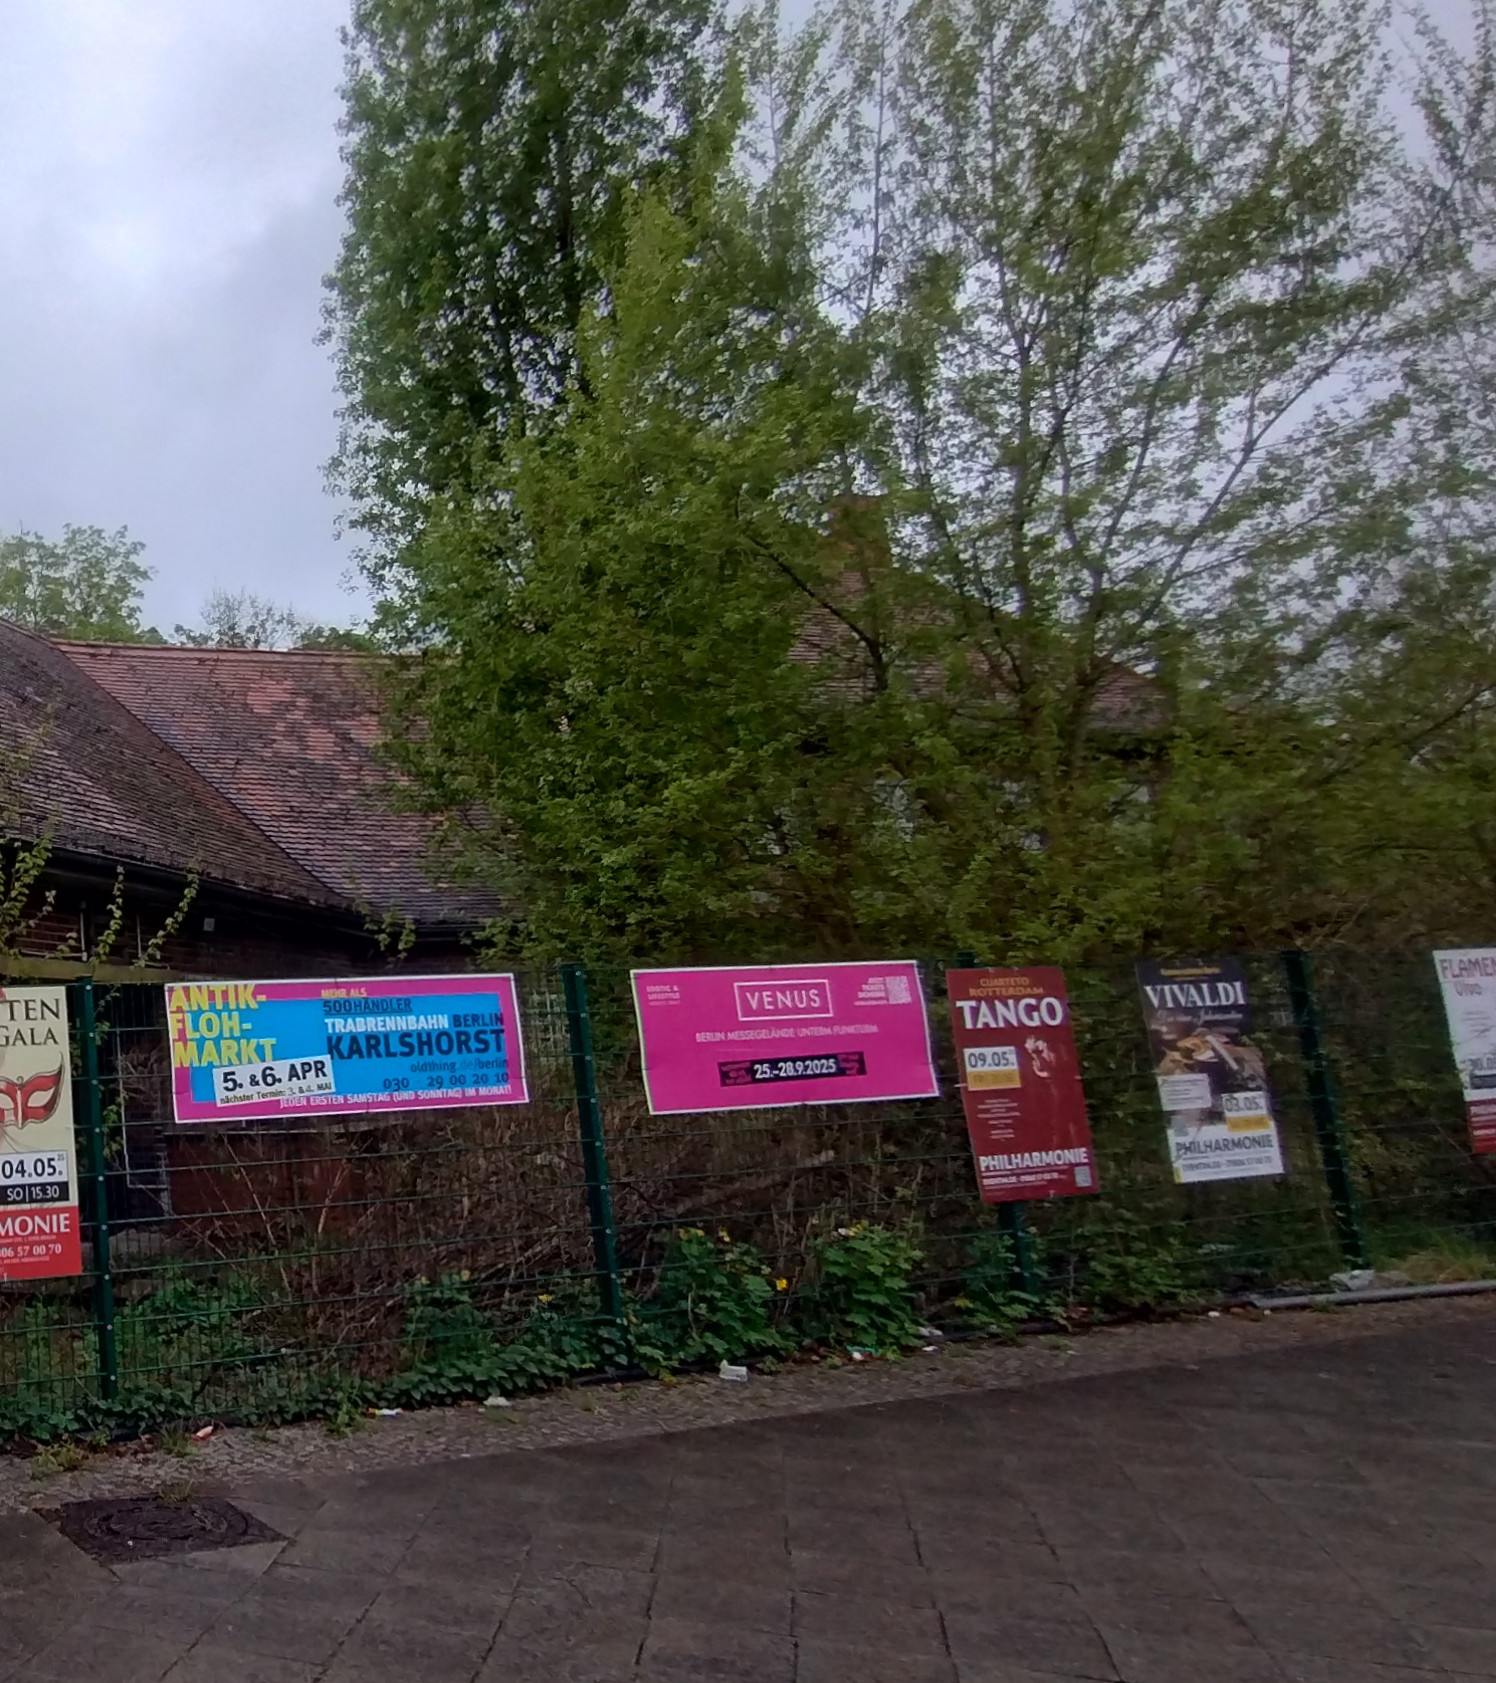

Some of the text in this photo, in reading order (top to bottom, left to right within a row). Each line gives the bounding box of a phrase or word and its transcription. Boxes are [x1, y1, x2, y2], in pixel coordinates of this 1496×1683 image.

[169, 984, 267, 1011] ANTIK-
[350, 987, 367, 998] ALS
[746, 989, 821, 1010] VENUS
[968, 987, 1044, 997] ROTTERDAM
[1144, 981, 1246, 1009] VIVALDI
[324, 1012, 504, 1033] TRABRENNBAHN BERLIN
[955, 997, 1063, 1029] TANGO
[169, 1011, 252, 1039] FLOH-
[695, 1031, 725, 1042] BERLIN
[727, 1027, 795, 1041] MESSEGELÄNDE
[797, 1026, 832, 1037] UNTERM
[173, 1038, 277, 1068] MARKT
[326, 1028, 505, 1061] KARLSHORST
[968, 1051, 1015, 1068] 09.05.
[222, 1070, 244, 1092] 5.
[287, 1060, 328, 1082] APR
[383, 1072, 509, 1091] 030 29 00 20 10
[220, 1093, 254, 1105] nächster
[280, 1084, 512, 1109] JEDEN ERSTEN SAMSTAG (UND SONNTAG) IM MONAT!
[1175, 1134, 1273, 1156] PHILHARMONIE
[1, 1157, 63, 1180] 04.05.
[979, 1148, 1089, 1171] PHILHARMONIE
[6, 1185, 60, 1202] SO 15.30
[17, 1245, 29, 1256] 57
[32, 1244, 46, 1255] 00
[48, 1243, 62, 1254] 70
